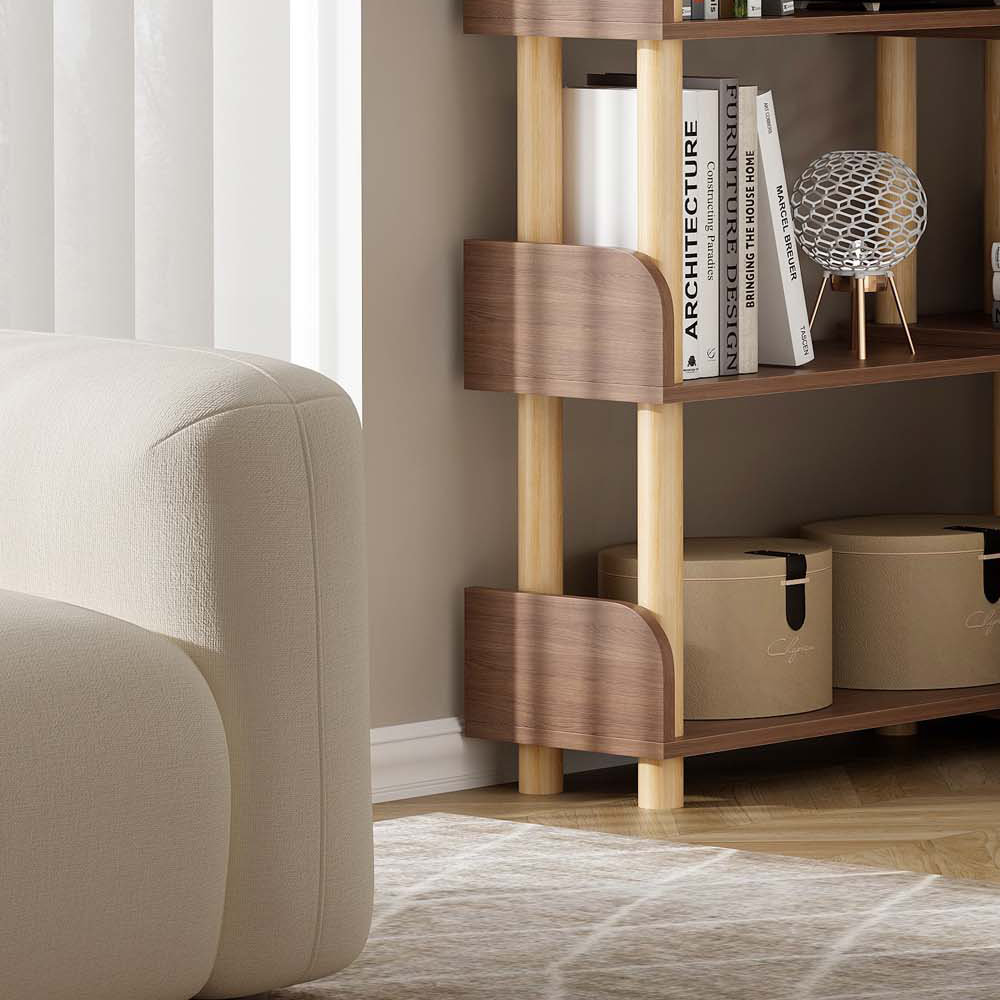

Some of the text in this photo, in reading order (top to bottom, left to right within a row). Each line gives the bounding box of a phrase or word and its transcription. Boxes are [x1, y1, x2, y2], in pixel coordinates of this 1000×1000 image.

[684, 120, 698, 340] ARCHITECTURE
[704, 161, 716, 231] Constructing
[726, 84, 738, 371] FURNITURE DESIGN
[745, 151, 755, 308] BRINGING THE HOUSE HOME
[776, 184, 797, 281] MARCEL BREUER
